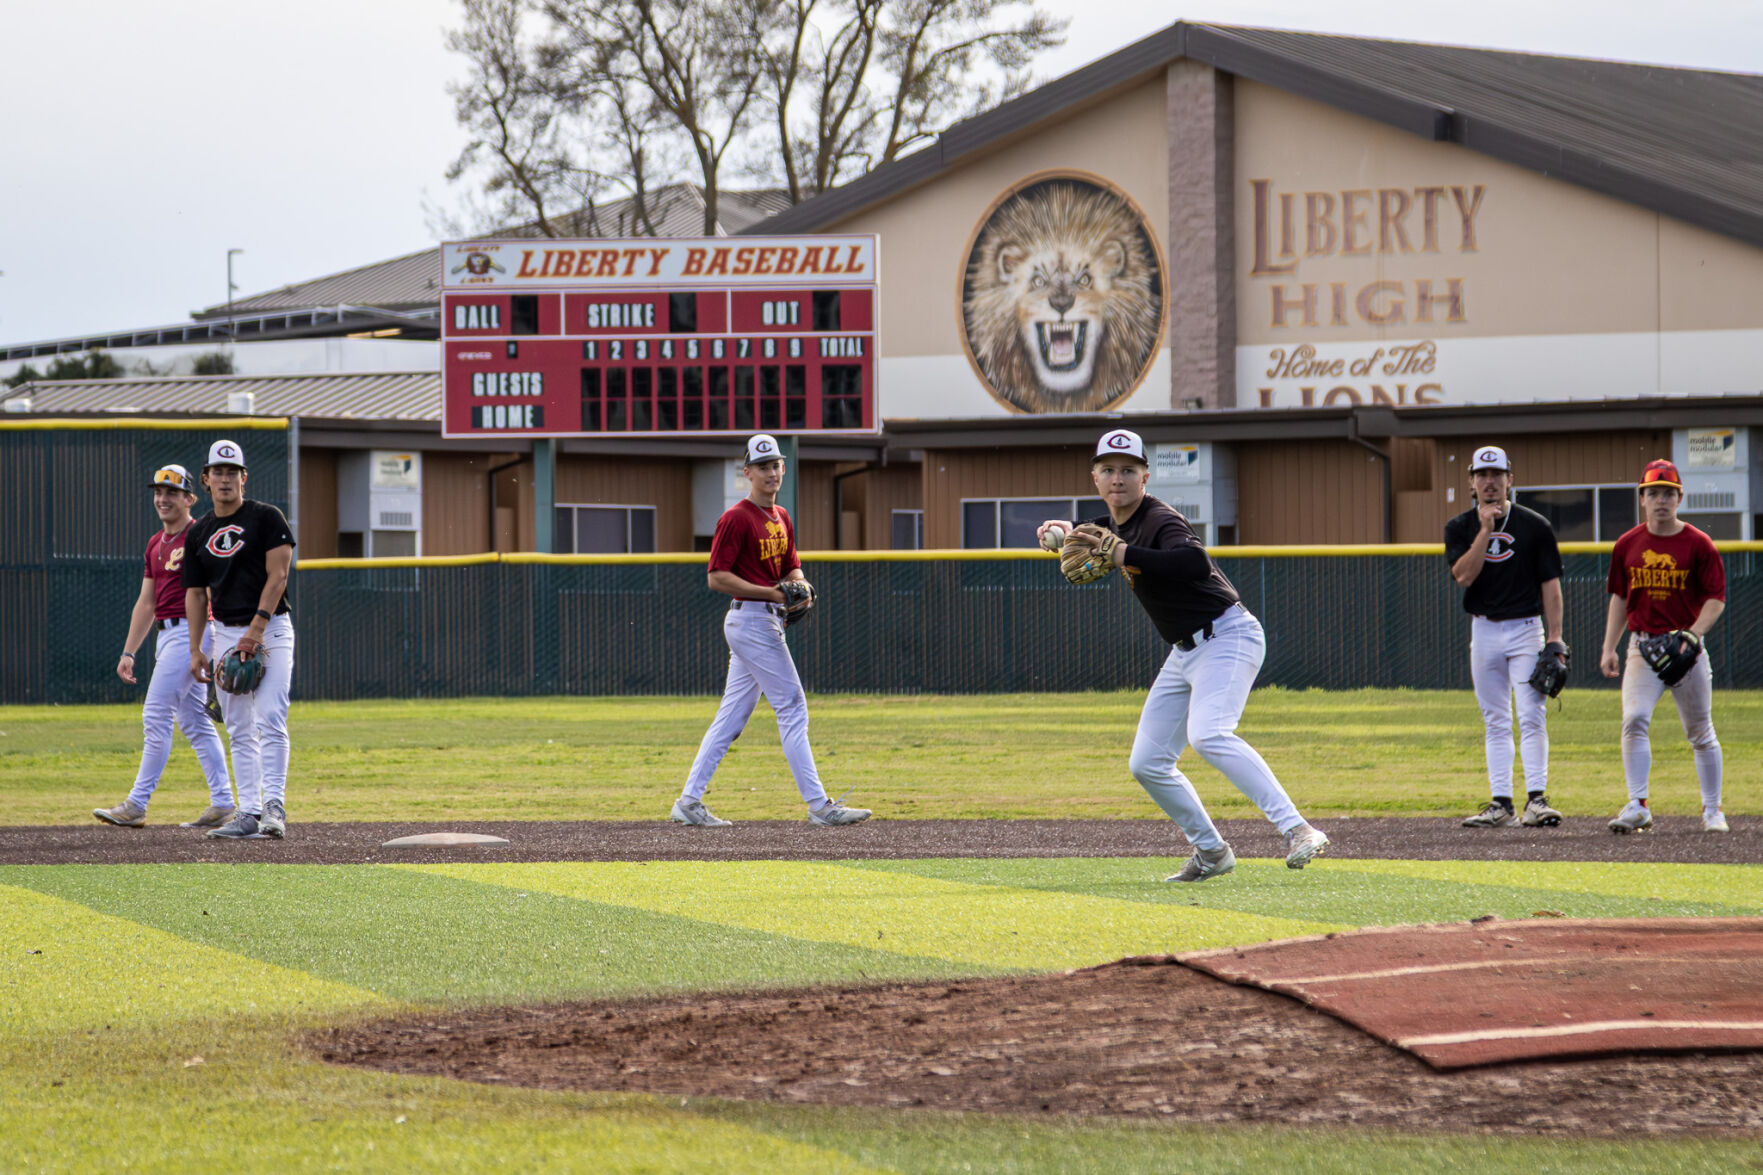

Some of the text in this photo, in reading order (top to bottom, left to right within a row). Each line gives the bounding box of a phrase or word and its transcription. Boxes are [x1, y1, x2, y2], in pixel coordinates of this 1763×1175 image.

[1249, 178, 1487, 277] LIBERTY
[515, 244, 866, 279] LIBERTY BASEBALL
[587, 303, 656, 328] STRIKE
[762, 301, 800, 325] OUT
[1269, 278, 1466, 329] HIGH
[454, 304, 501, 329] BALL
[586, 342, 595, 360] 1
[610, 342, 621, 360] 2
[635, 341, 647, 360] 3
[660, 340, 672, 359] 4
[686, 340, 699, 359] 5
[739, 339, 750, 358] 7
[820, 337, 864, 358] TOTAL
[1266, 340, 1437, 379] Home of The
[472, 372, 544, 397] GUESTS
[481, 404, 535, 429] HOME
[1630, 566, 1690, 590] LIBERTY
